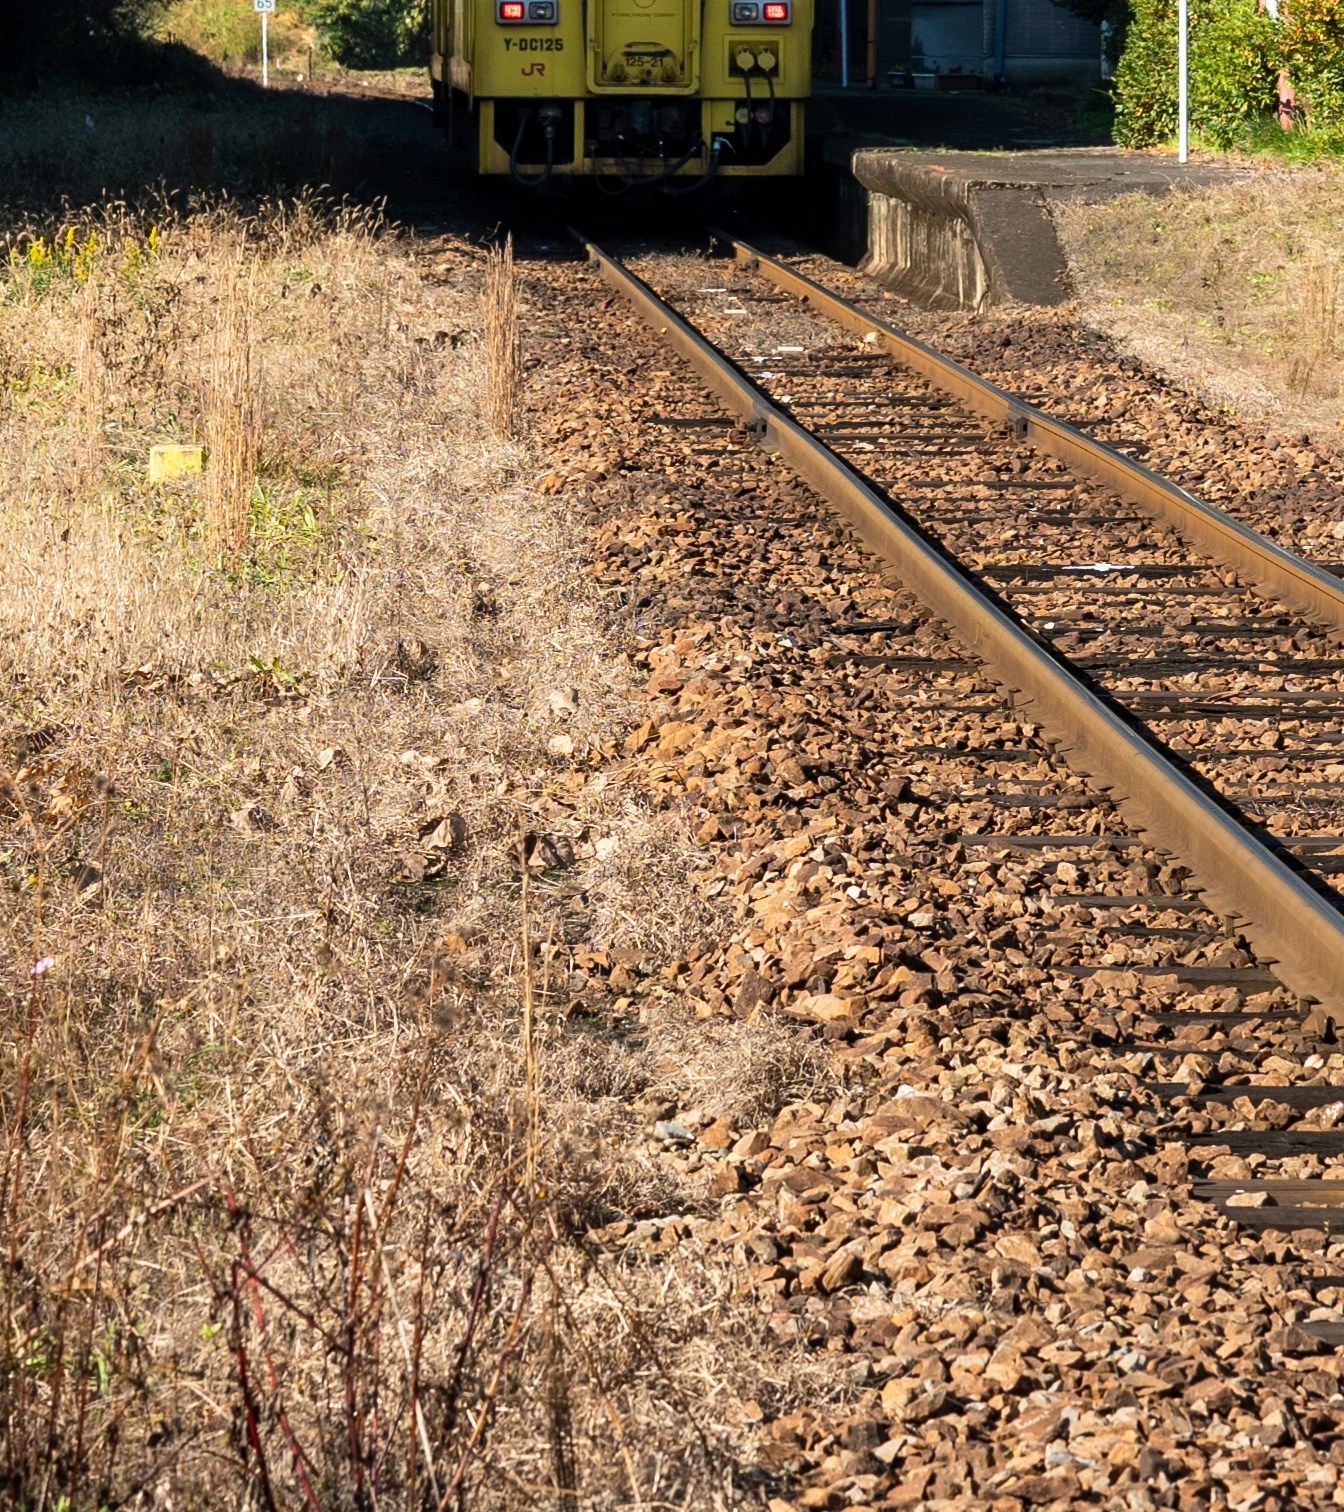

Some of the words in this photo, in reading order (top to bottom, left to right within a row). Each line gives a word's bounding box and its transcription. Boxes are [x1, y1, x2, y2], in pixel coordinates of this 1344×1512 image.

[503, 37, 564, 52] Y-DC125
[624, 56, 664, 69] 125-21
[521, 63, 546, 77] JR
